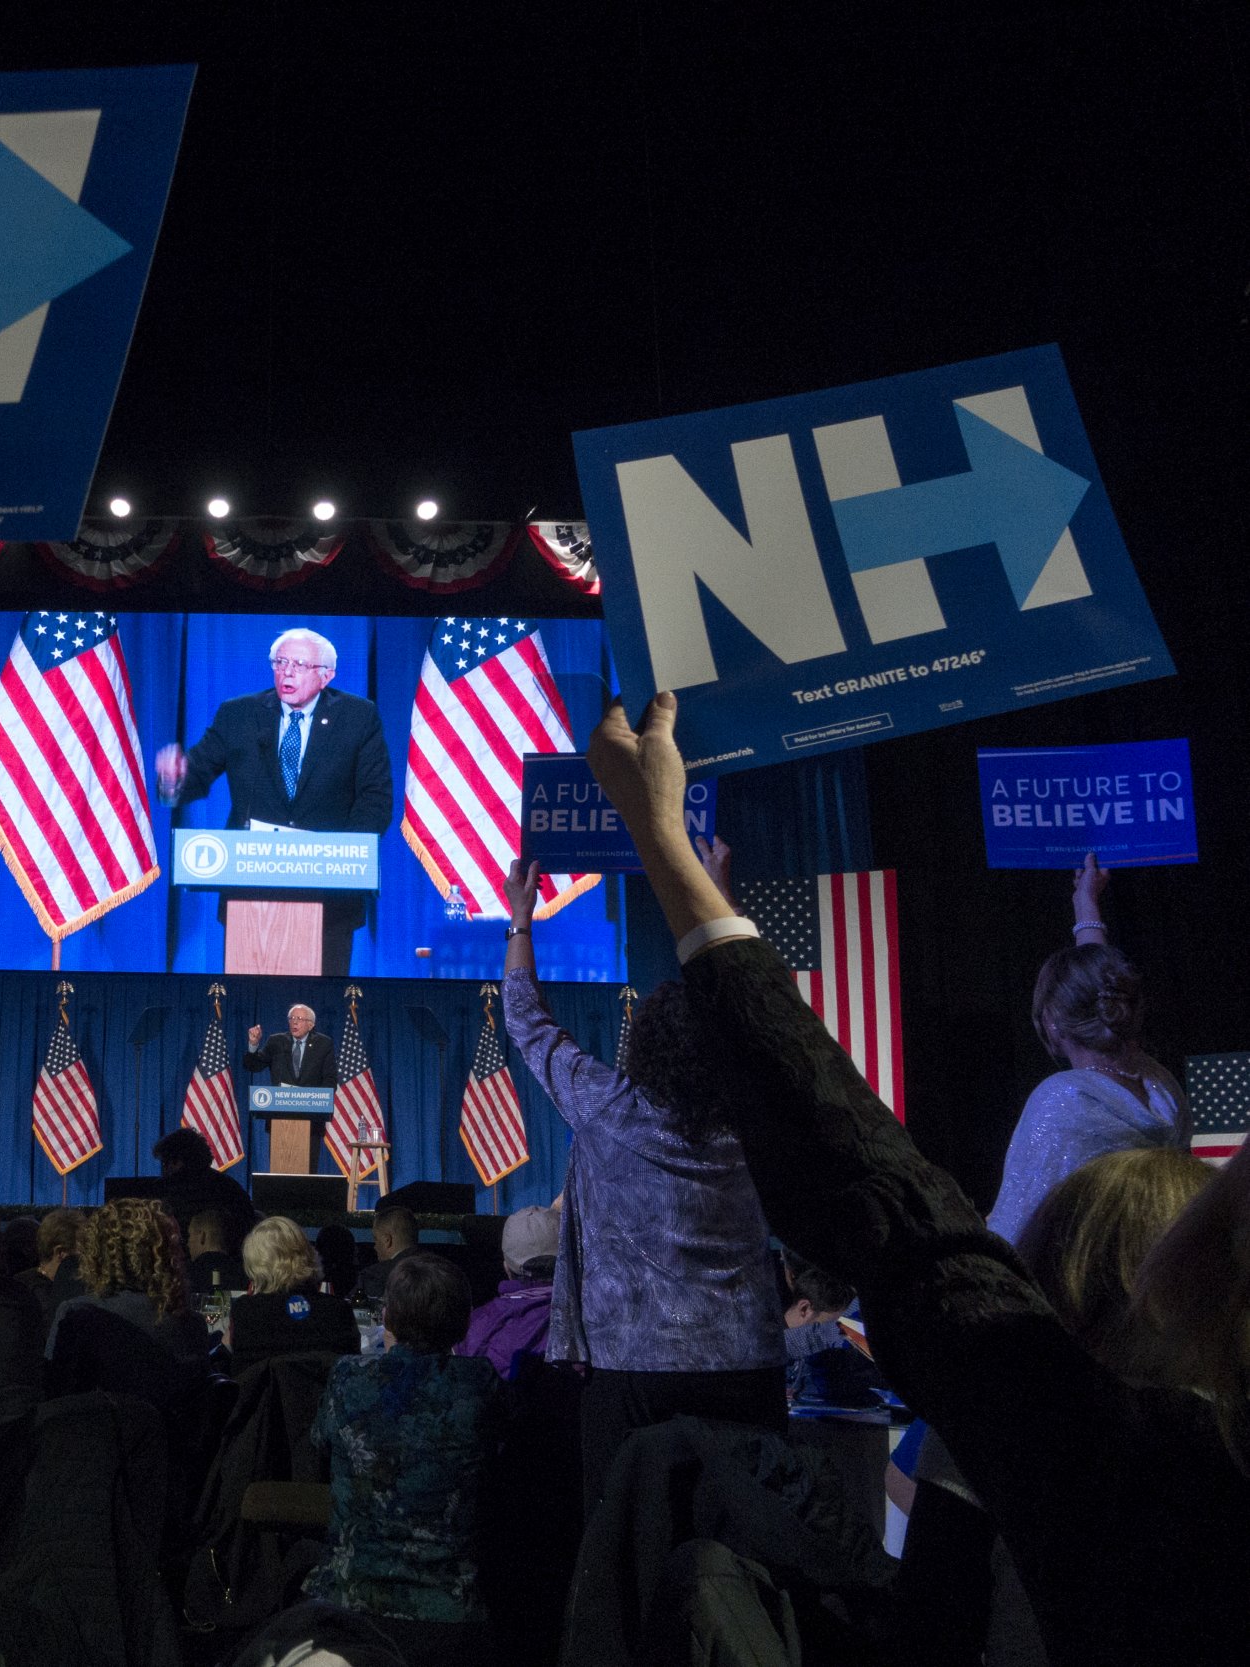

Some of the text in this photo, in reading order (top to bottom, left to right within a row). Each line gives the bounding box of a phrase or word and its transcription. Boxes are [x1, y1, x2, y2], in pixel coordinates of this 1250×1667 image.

[615, 386, 1091, 692] NH
[792, 683, 834, 704] Text
[835, 667, 909, 696] GRANITE
[909, 662, 929, 679] to
[532, 783, 708, 804] A FUT O
[991, 771, 1182, 798] A FUTURE TO
[530, 809, 706, 833] BELIE N
[992, 797, 1185, 827] BELIEVE IN
[235, 842, 369, 858] NEW HAMPSHIRE
[236, 861, 368, 876] DEMOCRATIC PARTY
[275, 1091, 291, 1099] NEW
[288, 1300, 311, 1314] NH
